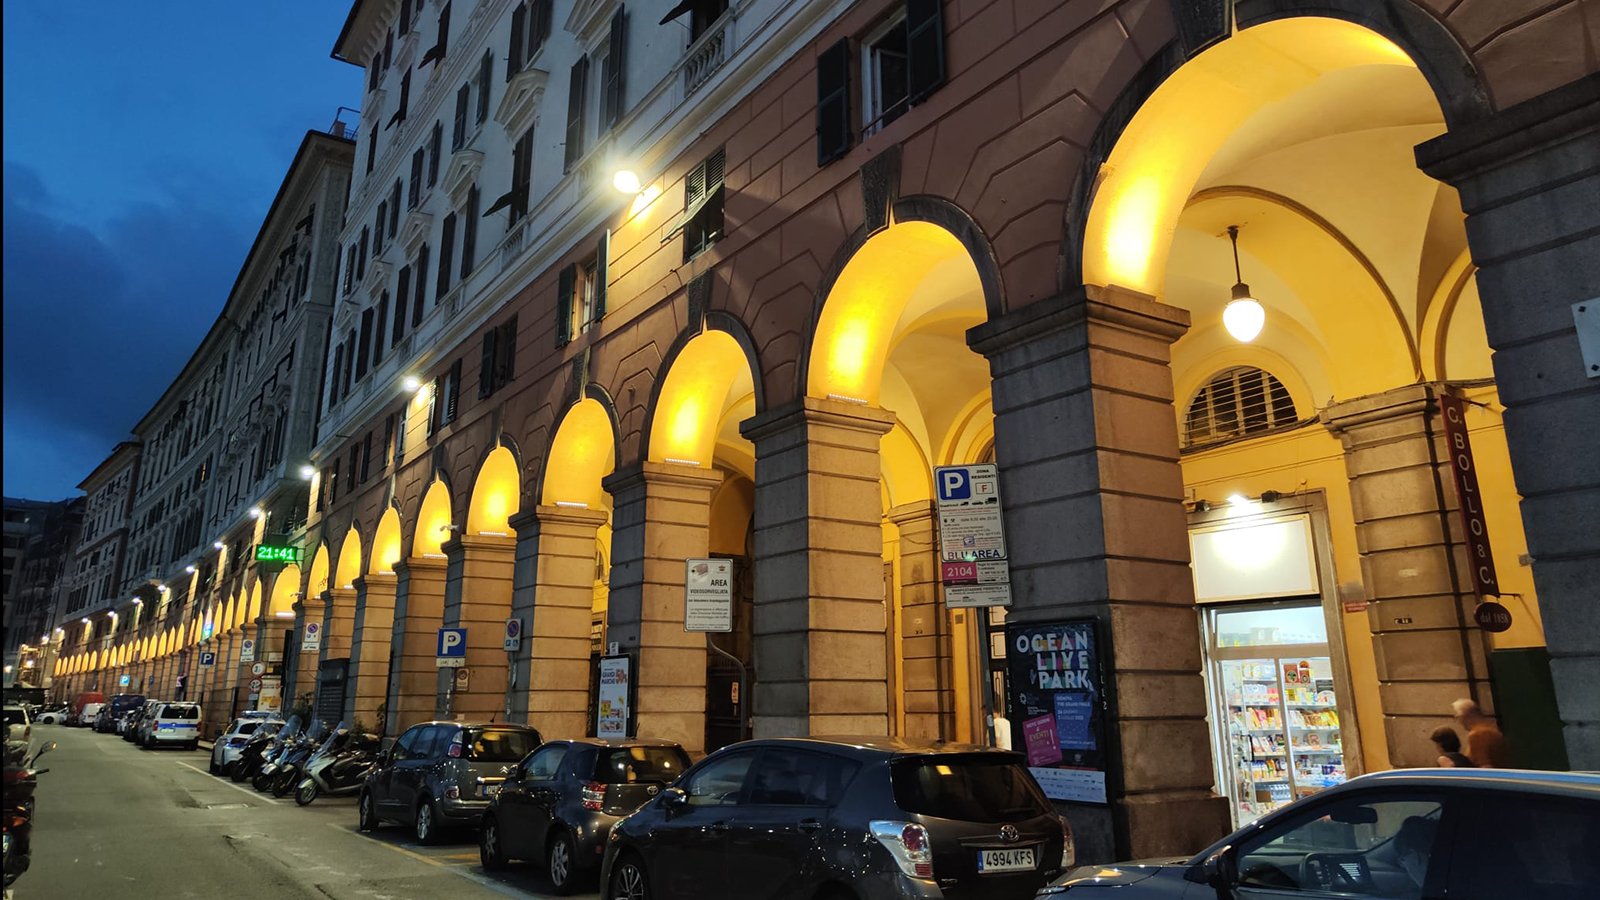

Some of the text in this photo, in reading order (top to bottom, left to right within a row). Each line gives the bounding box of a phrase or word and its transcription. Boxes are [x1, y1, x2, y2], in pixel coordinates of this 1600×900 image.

[944, 472, 964, 497] P
[1454, 433, 1481, 535] BOLLO
[1478, 544, 1485, 557] &
[258, 546, 294, 560] 21:41
[972, 549, 1000, 558] AREA
[947, 566, 973, 577] 2104
[1480, 612, 1491, 623] dal
[442, 631, 461, 654] P
[1016, 631, 1088, 653] OCEAN
[203, 653, 212, 663] P
[1036, 651, 1089, 671] LIVE
[1038, 670, 1089, 689] PARK
[986, 851, 1033, 866] 4994 KFS
